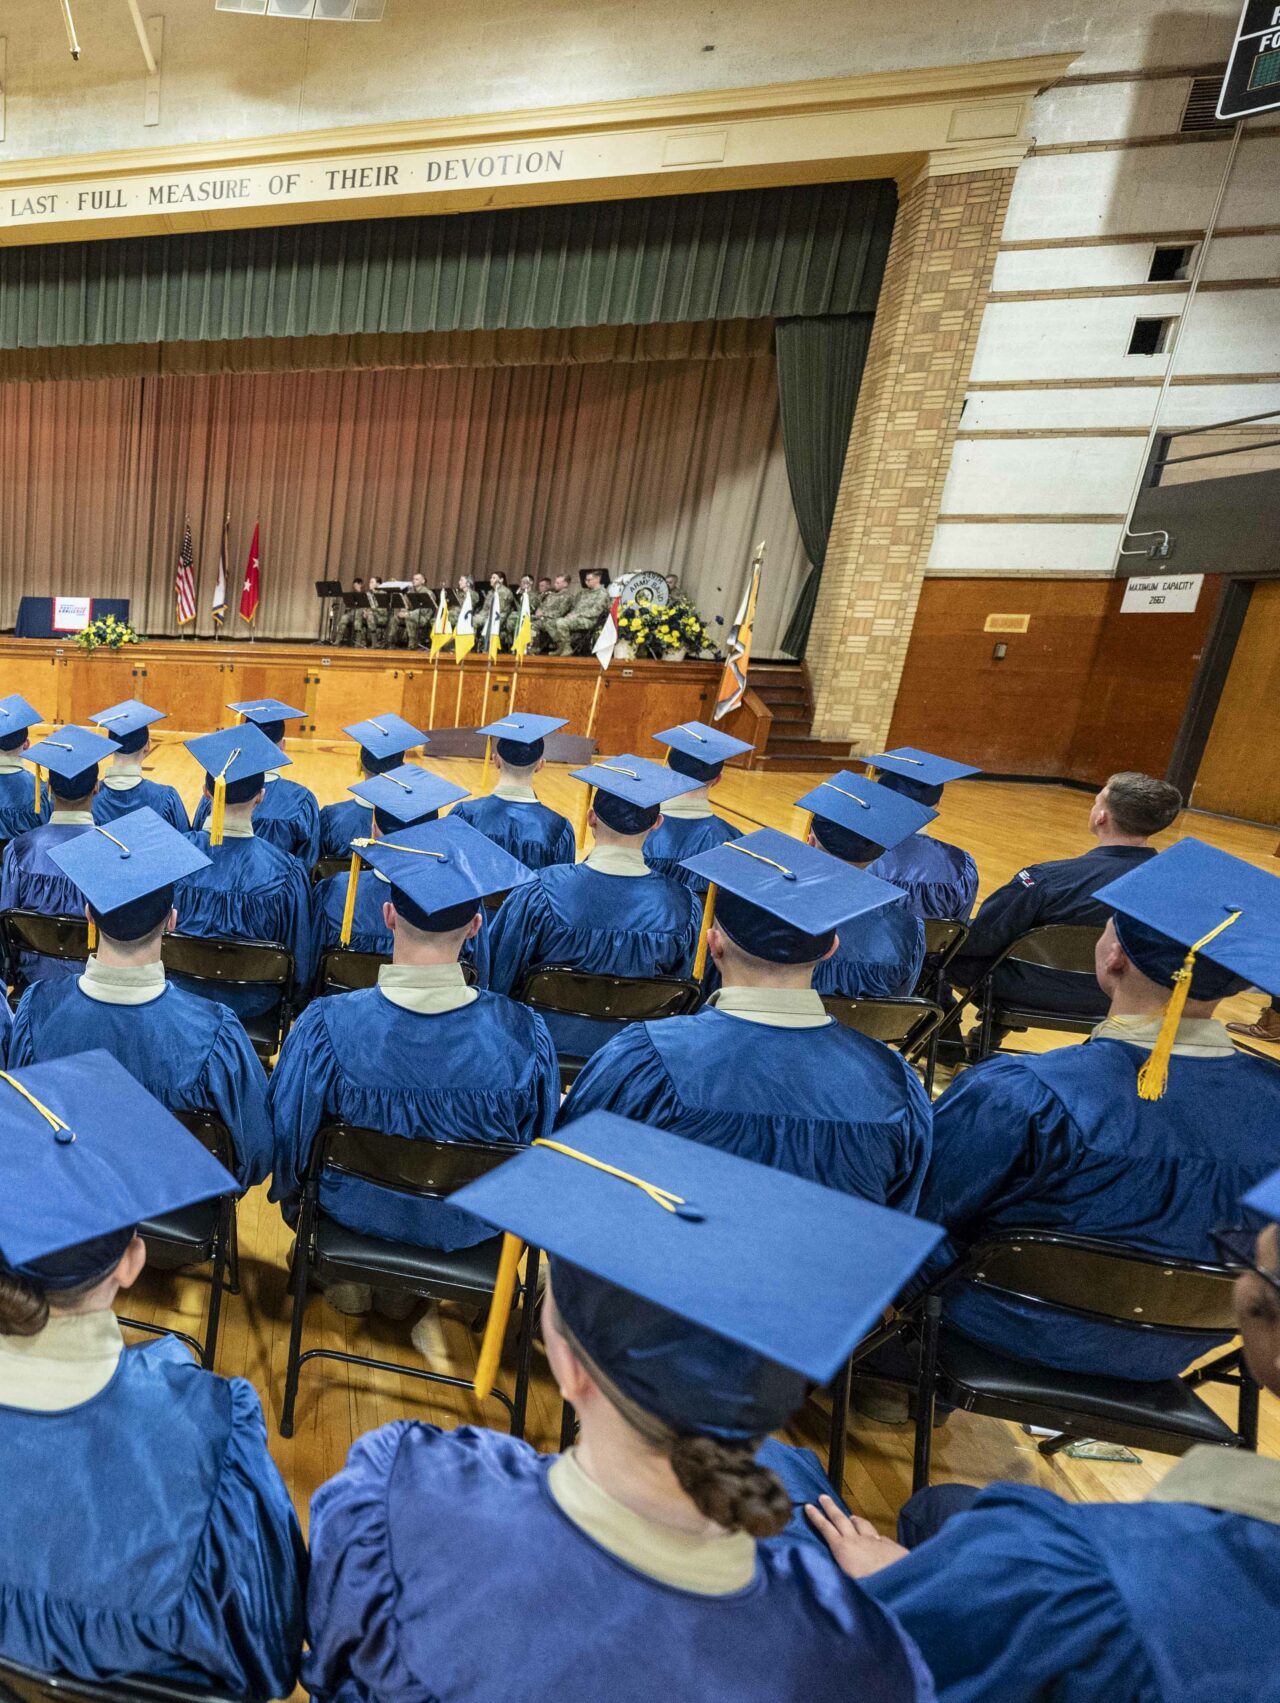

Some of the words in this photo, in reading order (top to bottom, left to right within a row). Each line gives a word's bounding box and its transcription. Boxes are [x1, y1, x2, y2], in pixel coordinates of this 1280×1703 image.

[10, 194, 59, 217] LAST
[77, 189, 128, 211] FULL
[148, 178, 251, 206] MEASURE
[268, 173, 300, 195] OF
[325, 165, 399, 190] THEIR
[426, 150, 564, 183] DEVOTION
[630, 579, 650, 592] ARMY
[1128, 582, 1159, 591] MAXIMUM
[1163, 581, 1195, 591] CAPACITY
